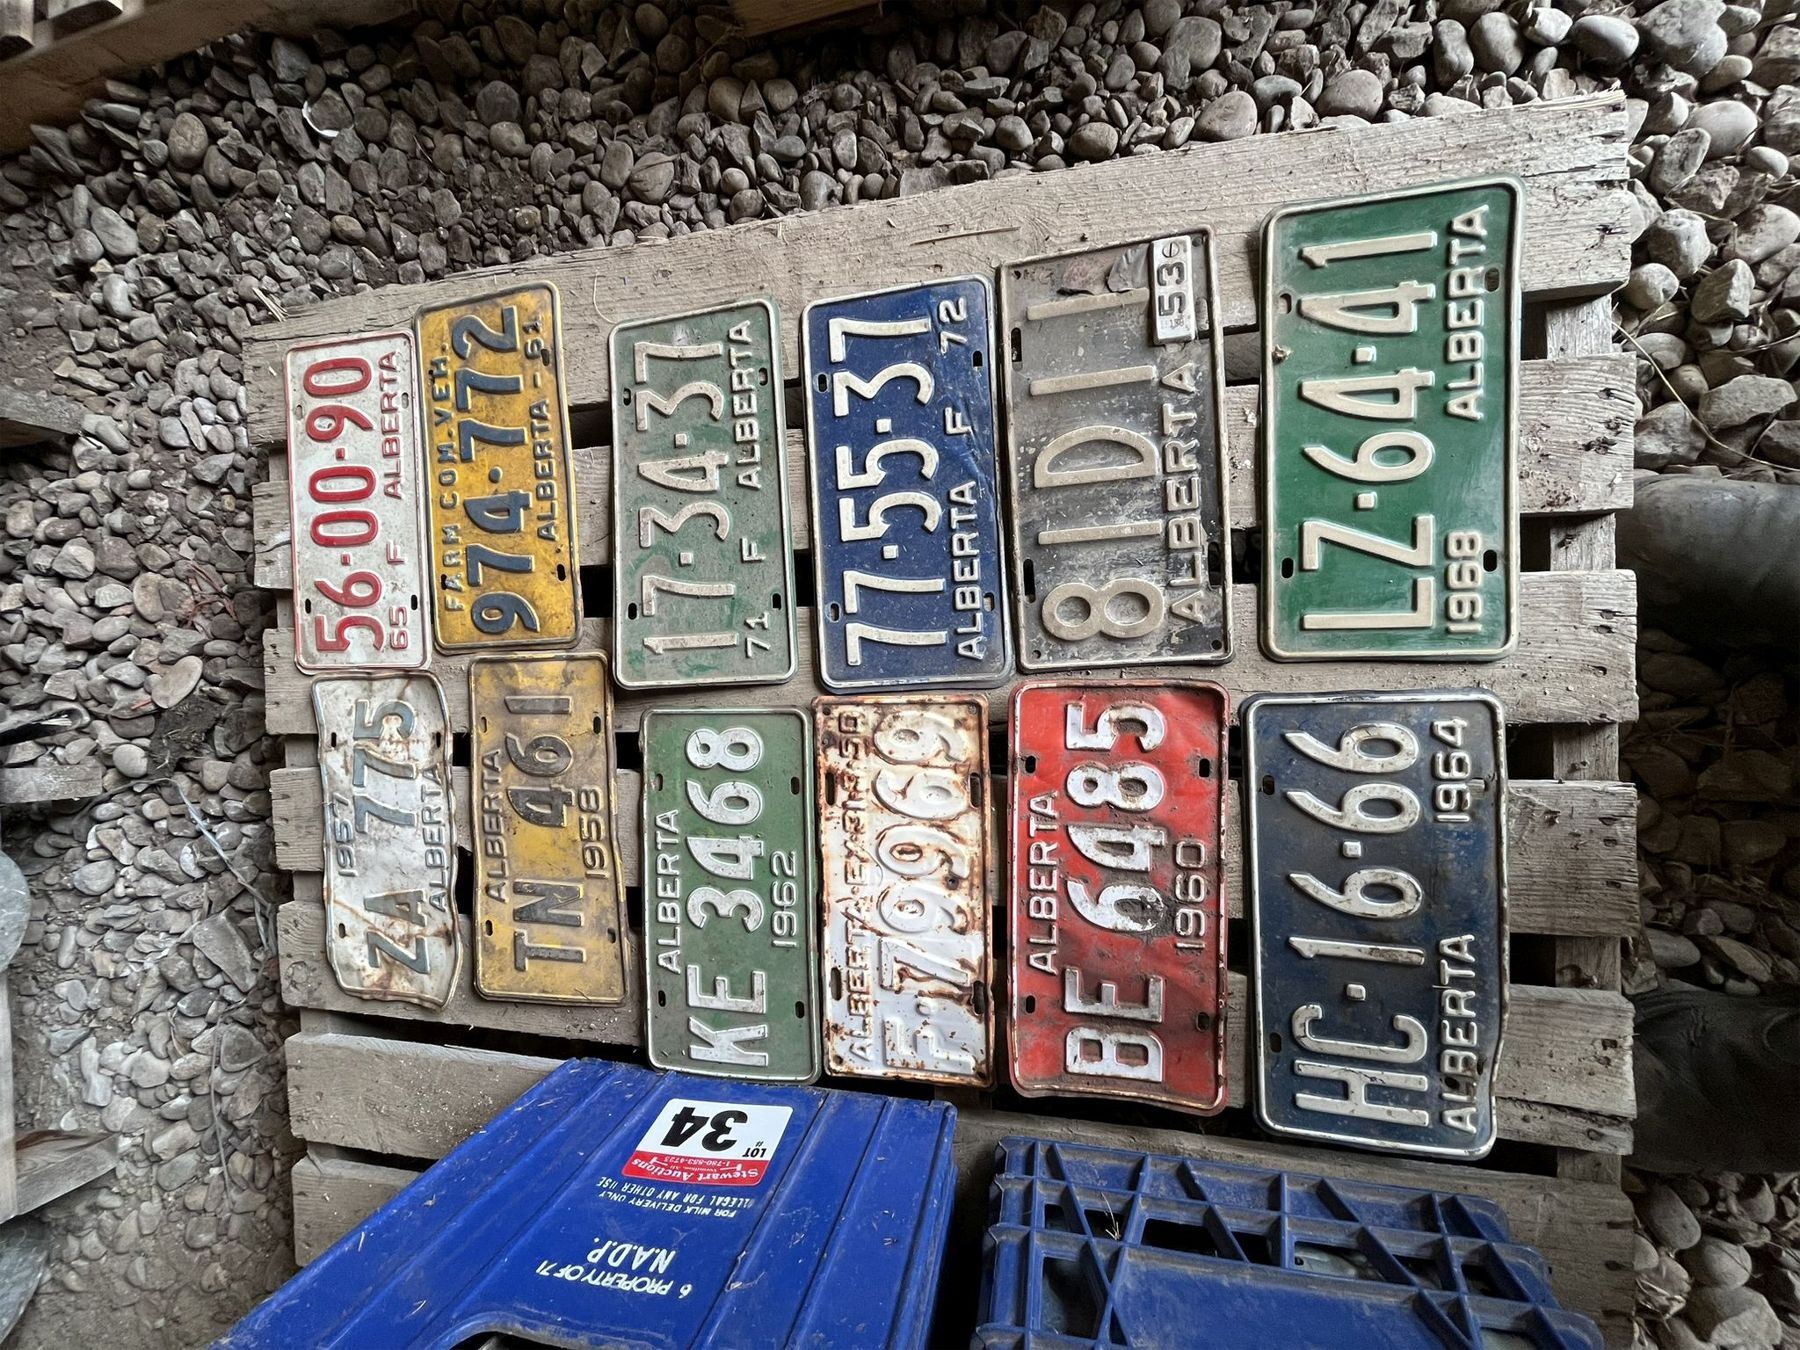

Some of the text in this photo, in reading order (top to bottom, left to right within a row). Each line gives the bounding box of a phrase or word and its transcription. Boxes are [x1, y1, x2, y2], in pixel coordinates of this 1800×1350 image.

[1157, 257, 1188, 318] 53
[530, 399, 559, 542] ALBERTA
[938, 298, 984, 660] ALBERTA F 72
[1444, 204, 1490, 635] 1968 ALBERTA
[379, 351, 408, 650] 65 F ALBERTA
[728, 319, 771, 658] 71 F ALBERTA
[1161, 362, 1205, 624] ALBERTA
[442, 524, 465, 612] FARM
[330, 792, 358, 878] 1957
[352, 699, 431, 976] ZA 775
[420, 764, 448, 912] ALBERTA
[481, 750, 509, 903] ALBERTA
[504, 695, 587, 972] TN 461
[579, 785, 609, 880] 1958
[1027, 790, 1060, 976] ALBERTA
[655, 809, 681, 975] ALBERTA
[686, 727, 768, 1067] KE 3468
[770, 850, 797, 948] 1962
[1065, 701, 1167, 1082] BE 6485
[1174, 839, 1207, 951] 1960
[1430, 716, 1478, 1134] ALBERTA 1964
[621, 1182, 656, 1196] OTHER
[631, 1158, 759, 1181] Stewart Auctions
[660, 1106, 748, 1152] 34
[742, 1147, 767, 1158] LOT
[599, 1190, 736, 1218] FOR MILK DELIVERY ONLY
[657, 1188, 682, 1201] ANY
[685, 1193, 706, 1205] FOR
[554, 1263, 583, 1282] OF
[582, 1268, 673, 1296] PROPERTY
